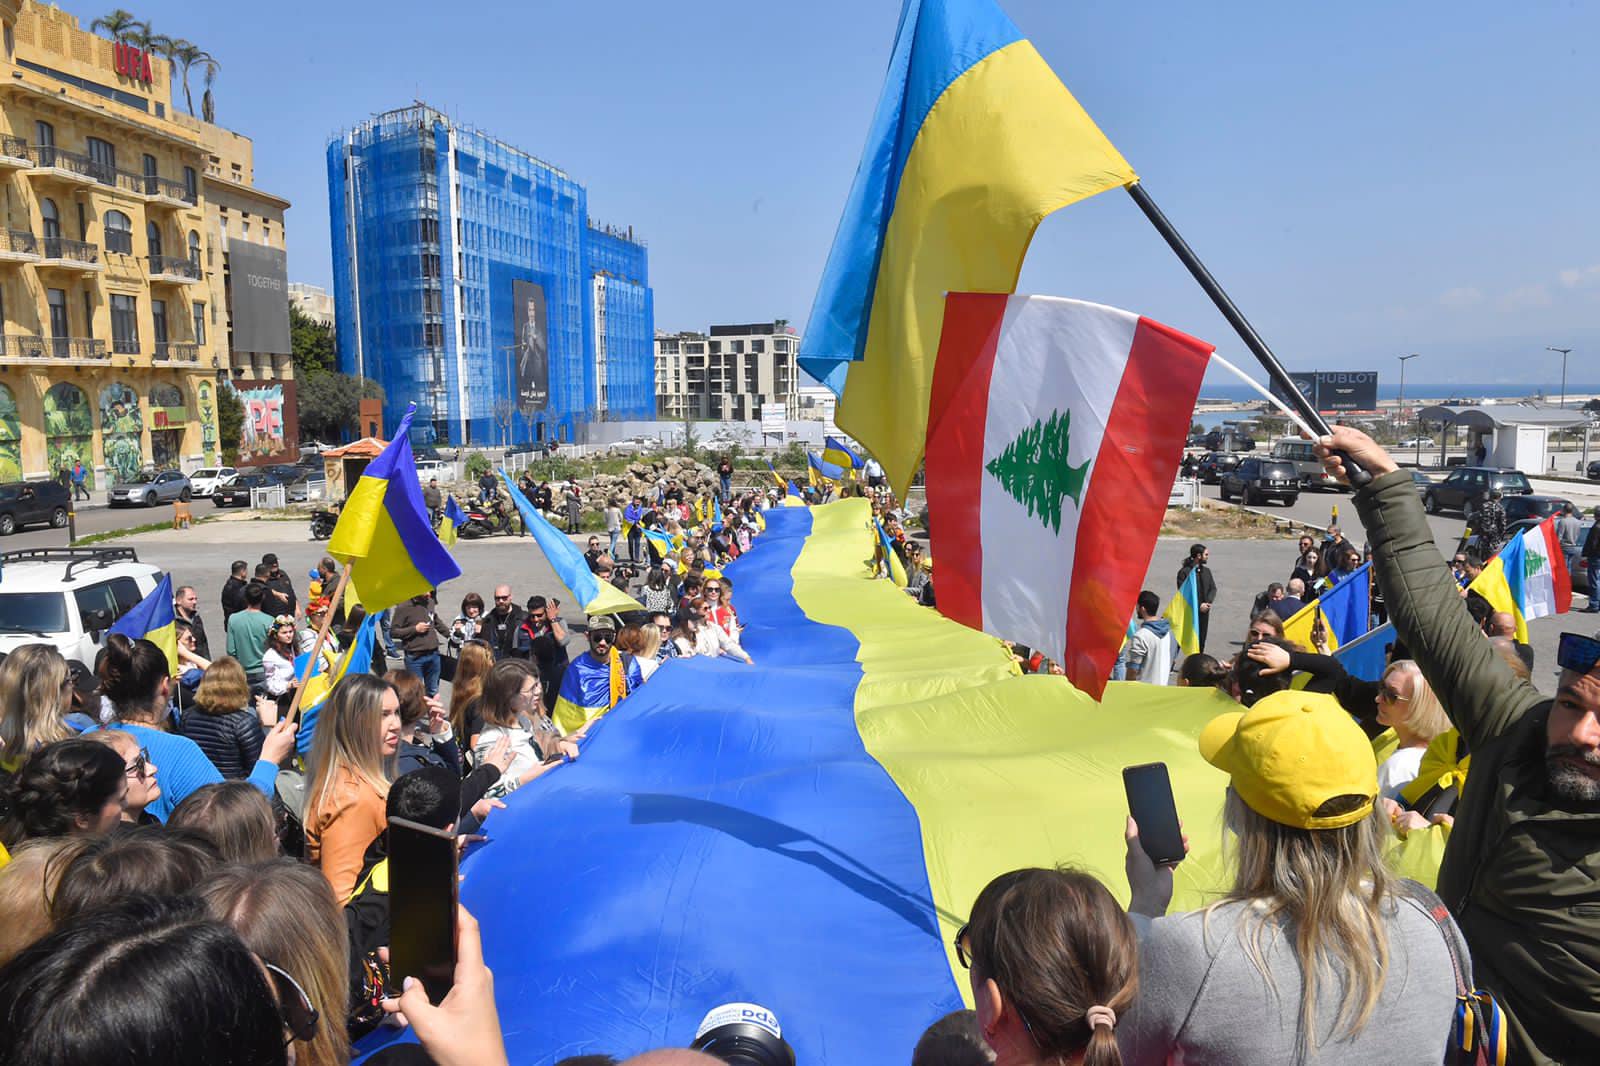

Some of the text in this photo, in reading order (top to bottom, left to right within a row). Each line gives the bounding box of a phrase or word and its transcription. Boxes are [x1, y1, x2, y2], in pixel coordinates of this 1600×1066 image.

[115, 41, 153, 83] UFA
[247, 273, 281, 290] TOGETHER
[1316, 373, 1376, 384] HUBLOT
